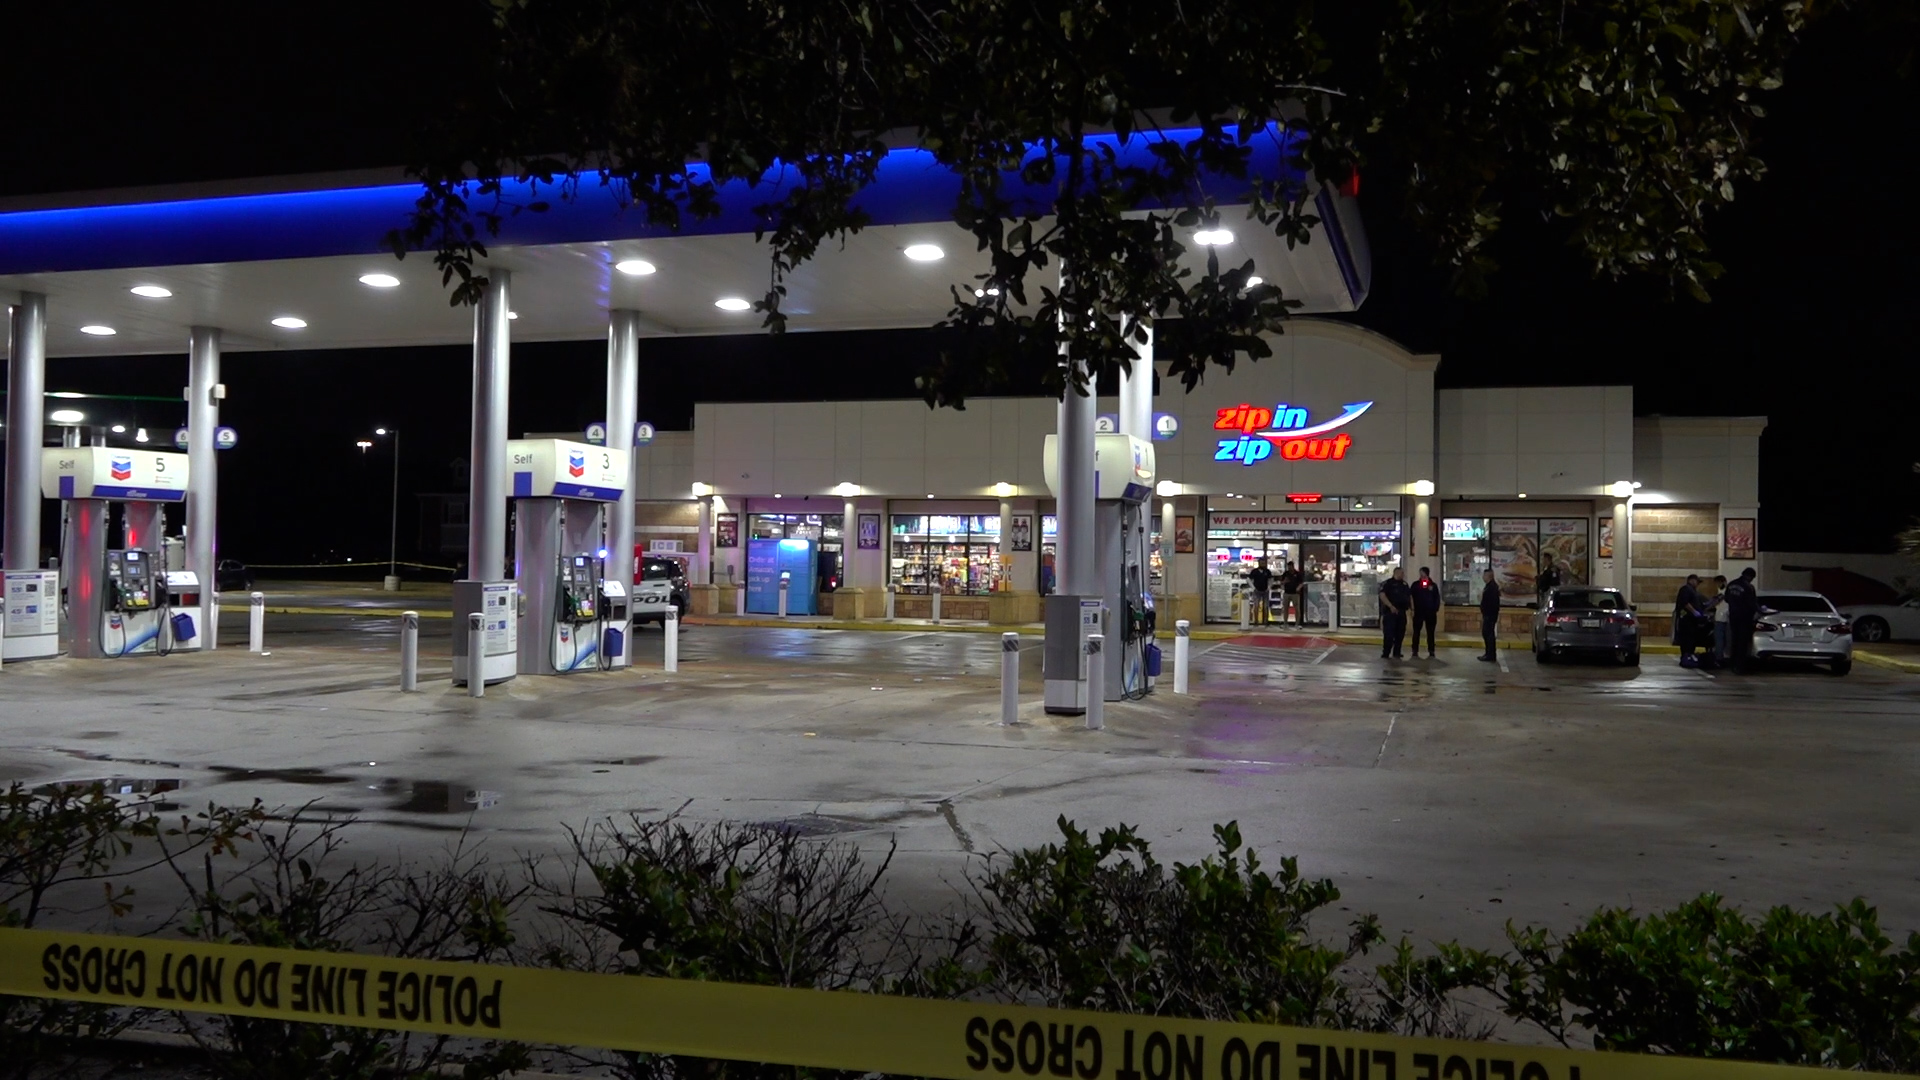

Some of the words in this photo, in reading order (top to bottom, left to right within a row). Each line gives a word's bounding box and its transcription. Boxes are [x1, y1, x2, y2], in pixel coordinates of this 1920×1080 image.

[1099, 420, 1107, 430] 2
[1214, 403, 1271, 434] zip
[1272, 403, 1309, 429] in
[180, 432, 186, 441] 6
[223, 432, 230, 441] 5
[592, 428, 599, 437] 4
[641, 427, 647, 437] 3
[514, 454, 532, 464] Self
[602, 453, 610, 470] 3
[1214, 436, 1272, 466] zip
[1280, 433, 1352, 461] out
[59, 459, 75, 470] Self
[155, 458, 165, 473] 5
[1213, 516, 1230, 525] WE
[1234, 516, 1299, 525] APPRECIATE
[1304, 516, 1336, 525] YOUR
[1339, 516, 1393, 526] BUSINESS
[42, 943, 146, 998] CROSS
[156, 953, 225, 1004] NOT
[234, 958, 282, 1009] DO
[291, 963, 367, 1018] LINE
[377, 970, 503, 1029] POLICE
[966, 1016, 1102, 1080] CROSS
[1116, 1029, 1204, 1080] NOT
[1221, 1037, 1280, 1080] DO
